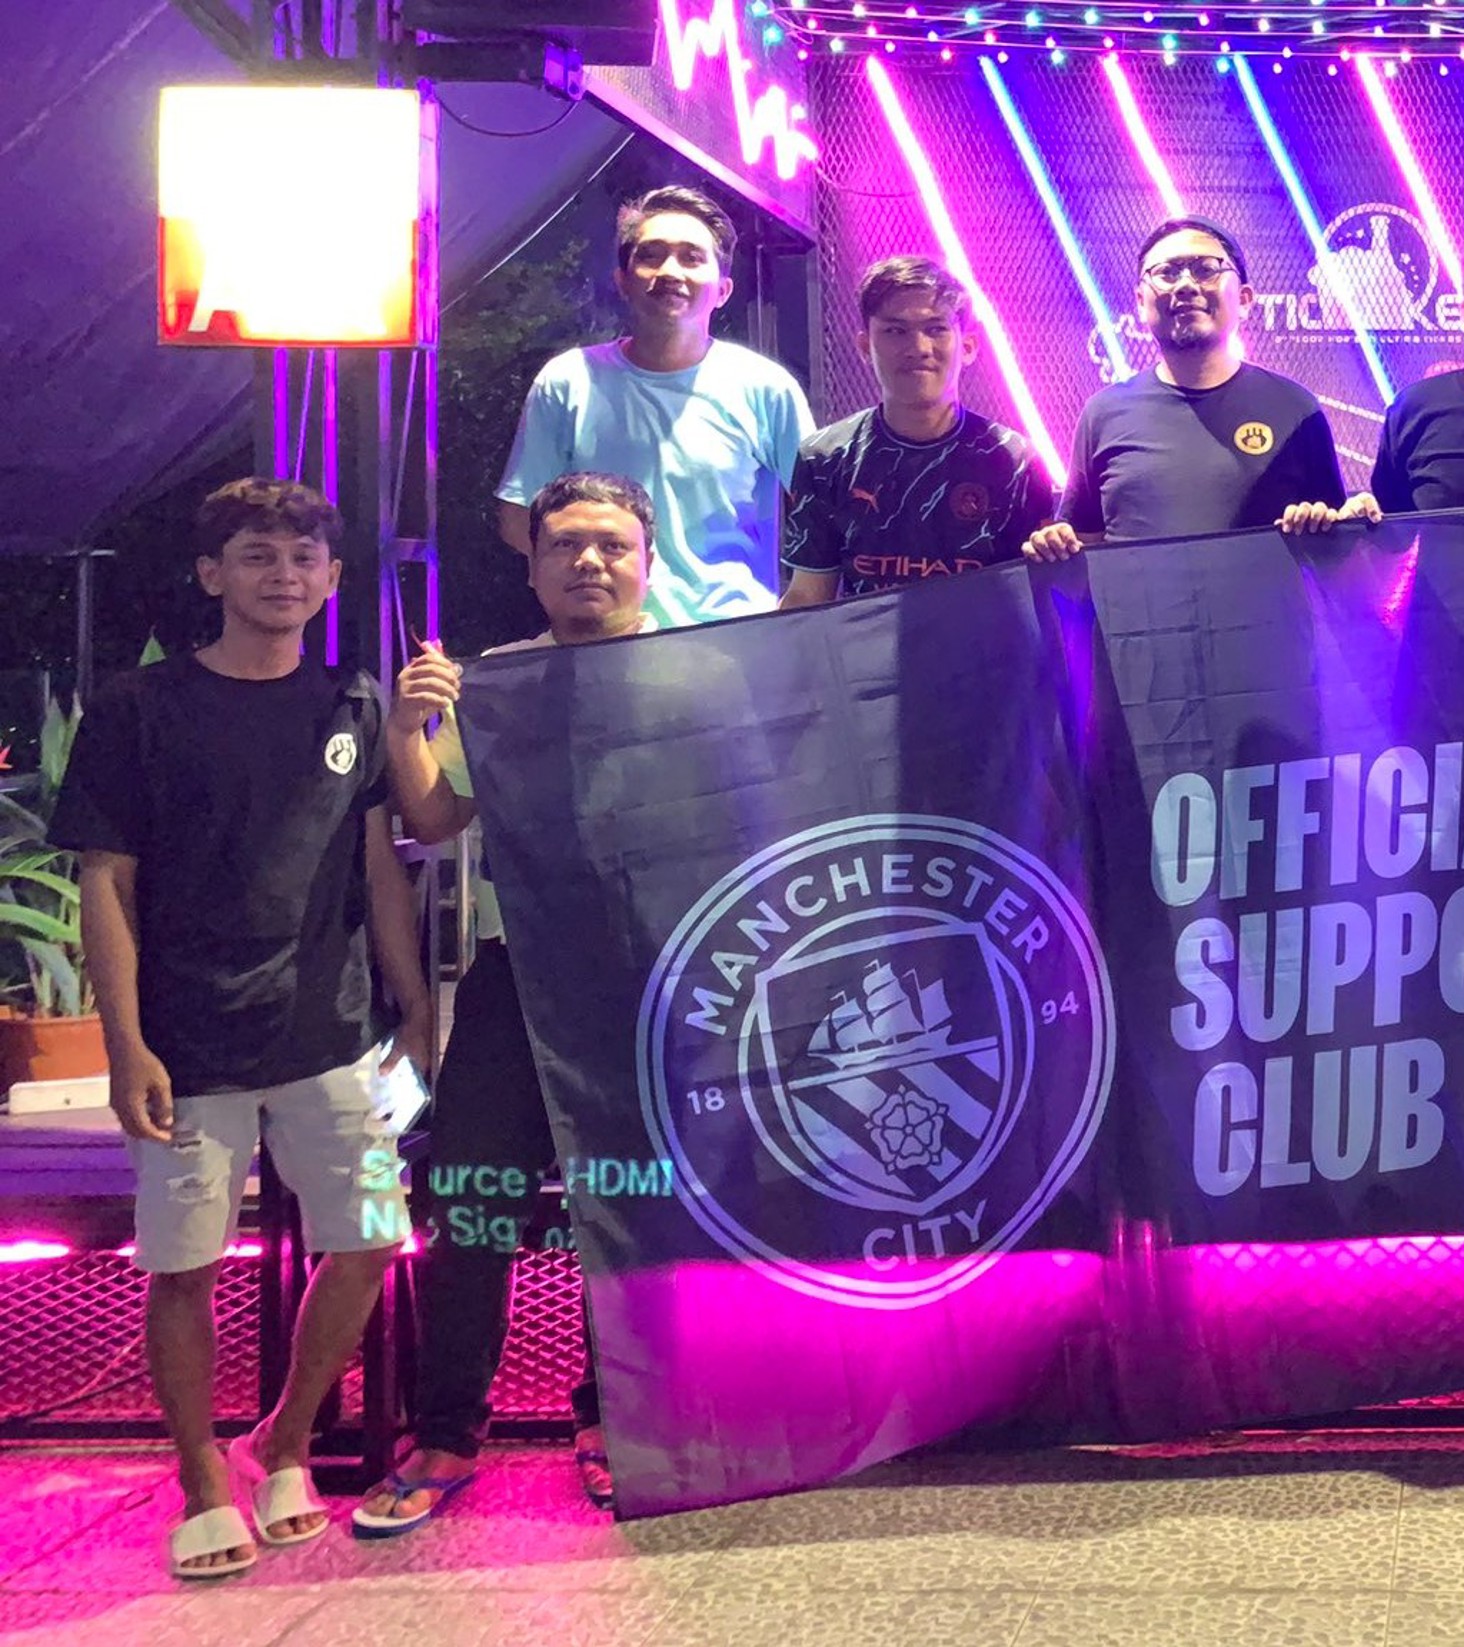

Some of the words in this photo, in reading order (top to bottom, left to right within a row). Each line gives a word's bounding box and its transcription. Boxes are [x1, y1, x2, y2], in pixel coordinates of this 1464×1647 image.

[684, 853, 1050, 1037] MANCHESTER
[1041, 990, 1079, 1025] 94
[686, 1086, 727, 1116] 18
[1192, 1038, 1446, 1198] CLUB
[862, 1199, 989, 1272] CITY
